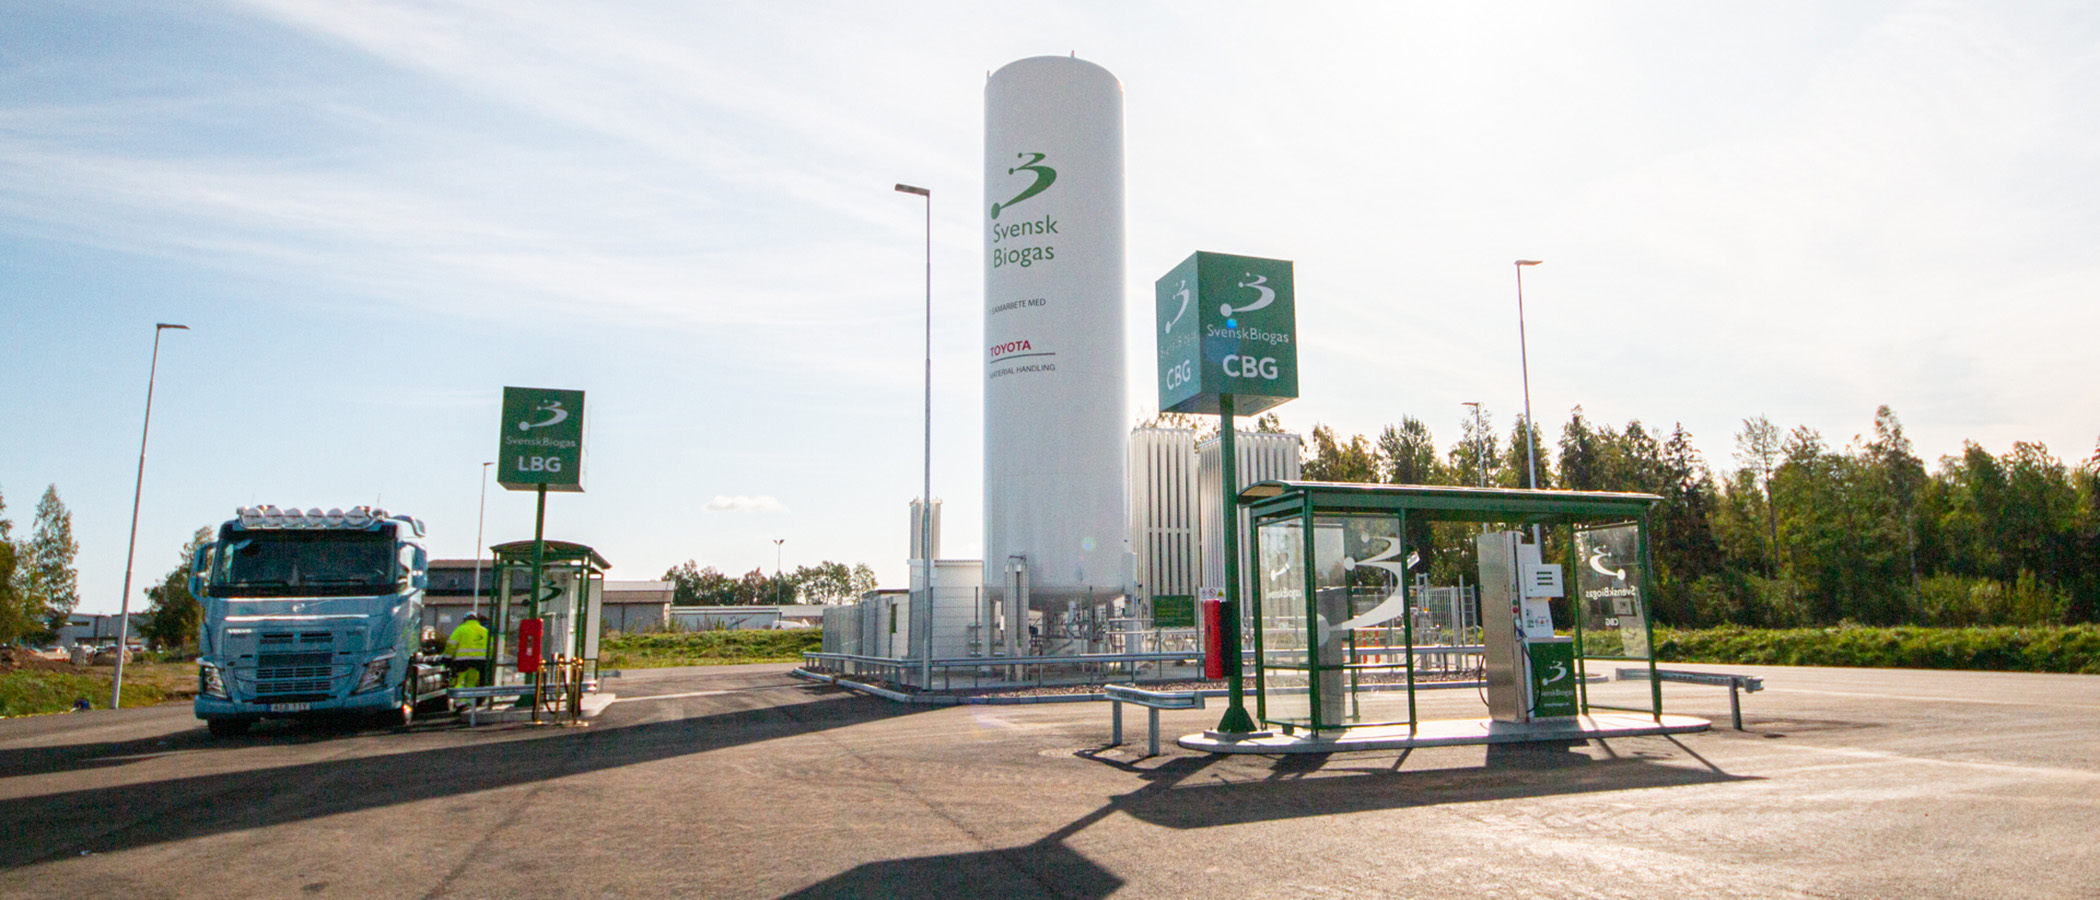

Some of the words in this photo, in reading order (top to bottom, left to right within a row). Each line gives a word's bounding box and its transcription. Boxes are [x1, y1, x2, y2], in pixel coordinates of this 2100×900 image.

[994, 214, 1059, 243] Svensk
[994, 246, 1055, 268] Biogas
[1028, 298, 1047, 307] MED
[1207, 323, 1290, 345] SvenskBiogas
[989, 340, 1032, 357] TOYOTA
[1016, 363, 1056, 373] HANDLING
[1166, 359, 1191, 390] CBG
[1222, 354, 1279, 380] CBG
[505, 435, 577, 449] SvenskBiogas
[518, 455, 562, 472] LBG
